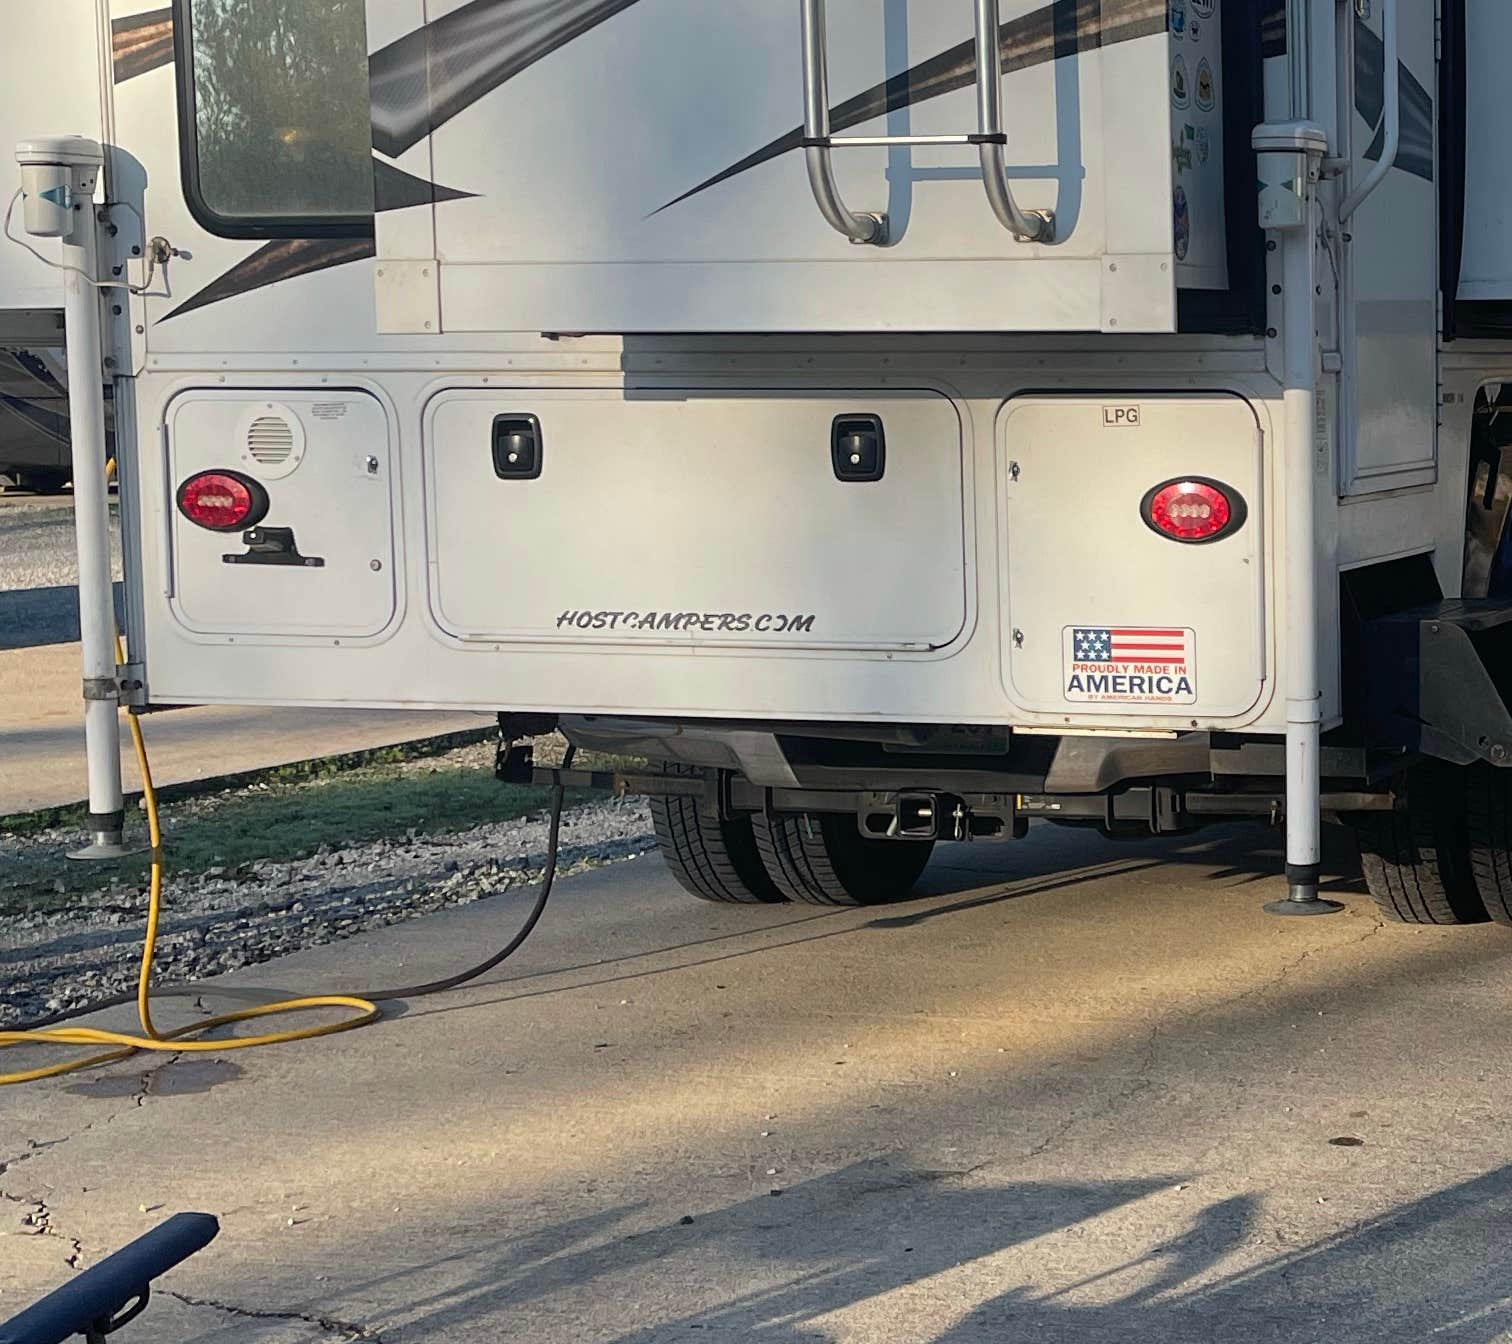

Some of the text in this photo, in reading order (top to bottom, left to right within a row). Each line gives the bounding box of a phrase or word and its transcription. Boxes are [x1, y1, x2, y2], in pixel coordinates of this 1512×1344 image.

[1104, 408, 1138, 423] LPG
[1072, 663, 1187, 675] PROUDLY MADE IN
[1067, 674, 1193, 695] AMERICA
